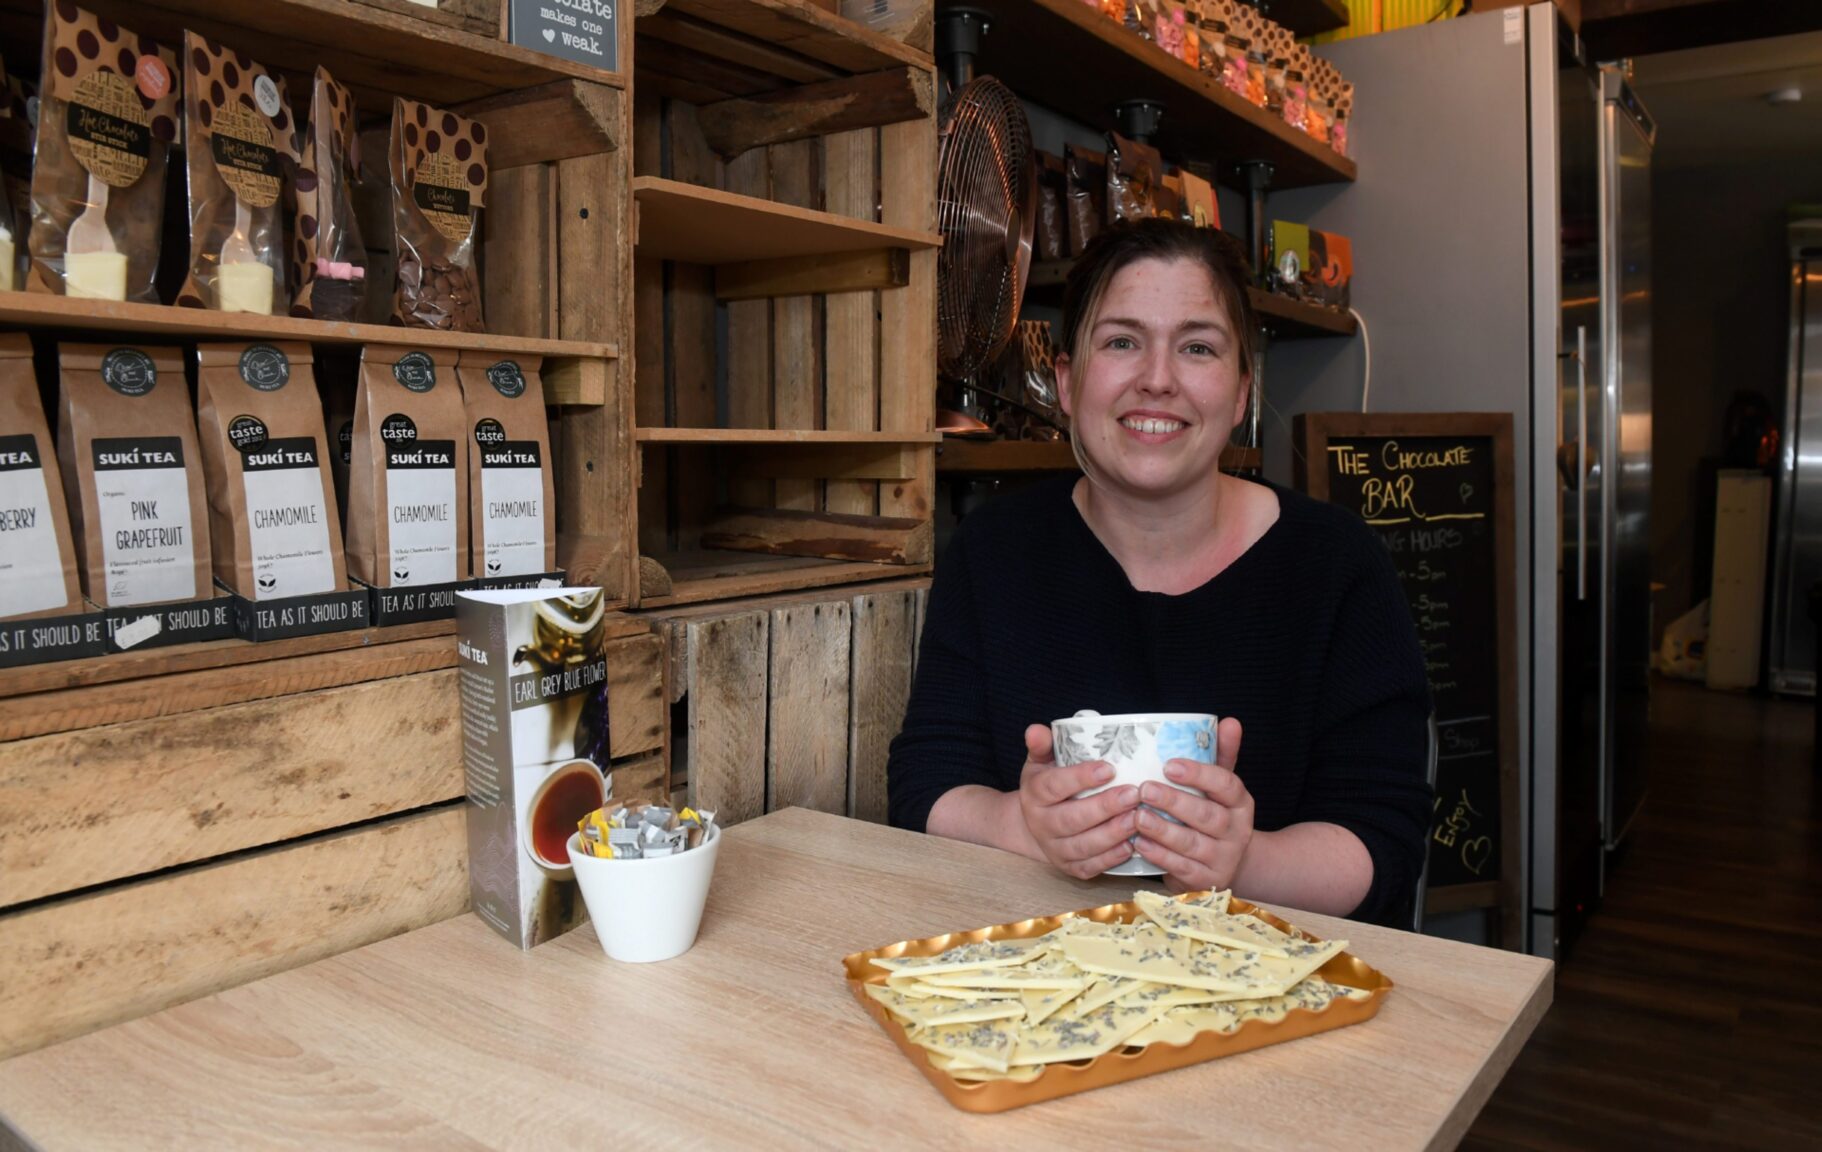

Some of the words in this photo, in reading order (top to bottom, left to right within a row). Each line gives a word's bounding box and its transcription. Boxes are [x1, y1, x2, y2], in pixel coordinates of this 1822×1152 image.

[540, 7, 577, 27] makes
[582, 20, 603, 35] one
[561, 31, 603, 56] weak.
[230, 424, 264, 440] taste
[382, 427, 416, 440] taste
[389, 420, 406, 429] great
[476, 431, 504, 442] taste
[0, 452, 32, 465] TEA
[142, 452, 177, 464] TEA
[286, 452, 314, 464] TEA
[425, 454, 449, 464] TEA
[514, 454, 537, 464] TEA
[1327, 445, 1371, 475] THE
[1361, 473, 1426, 518] BAR
[131, 501, 158, 521] PINK
[254, 505, 318, 529] CHAMOMILE
[394, 503, 449, 524] CHAMOMILE
[489, 500, 538, 519] CHAMOMILE
[116, 526, 184, 551] GRAPEFRUIT
[1411, 528, 1464, 553] HOURS
[381, 595, 400, 613] TEA
[402, 593, 415, 611] AS
[417, 591, 426, 610] IT
[428, 589, 457, 609] SHOUL
[168, 610, 210, 631] SHOULD
[214, 606, 228, 625] BE
[256, 609, 280, 629] TEA
[281, 608, 294, 627] AS
[298, 606, 306, 624] IT
[311, 603, 348, 623] SHOULD
[352, 600, 365, 618] BE
[15, 630, 27, 650] IT
[32, 627, 81, 648] SHOULD
[86, 622, 101, 642] BE
[471, 648, 489, 666] TEA
[515, 680, 538, 704] EARL
[541, 674, 562, 698] GREY
[564, 669, 582, 692] BLUE
